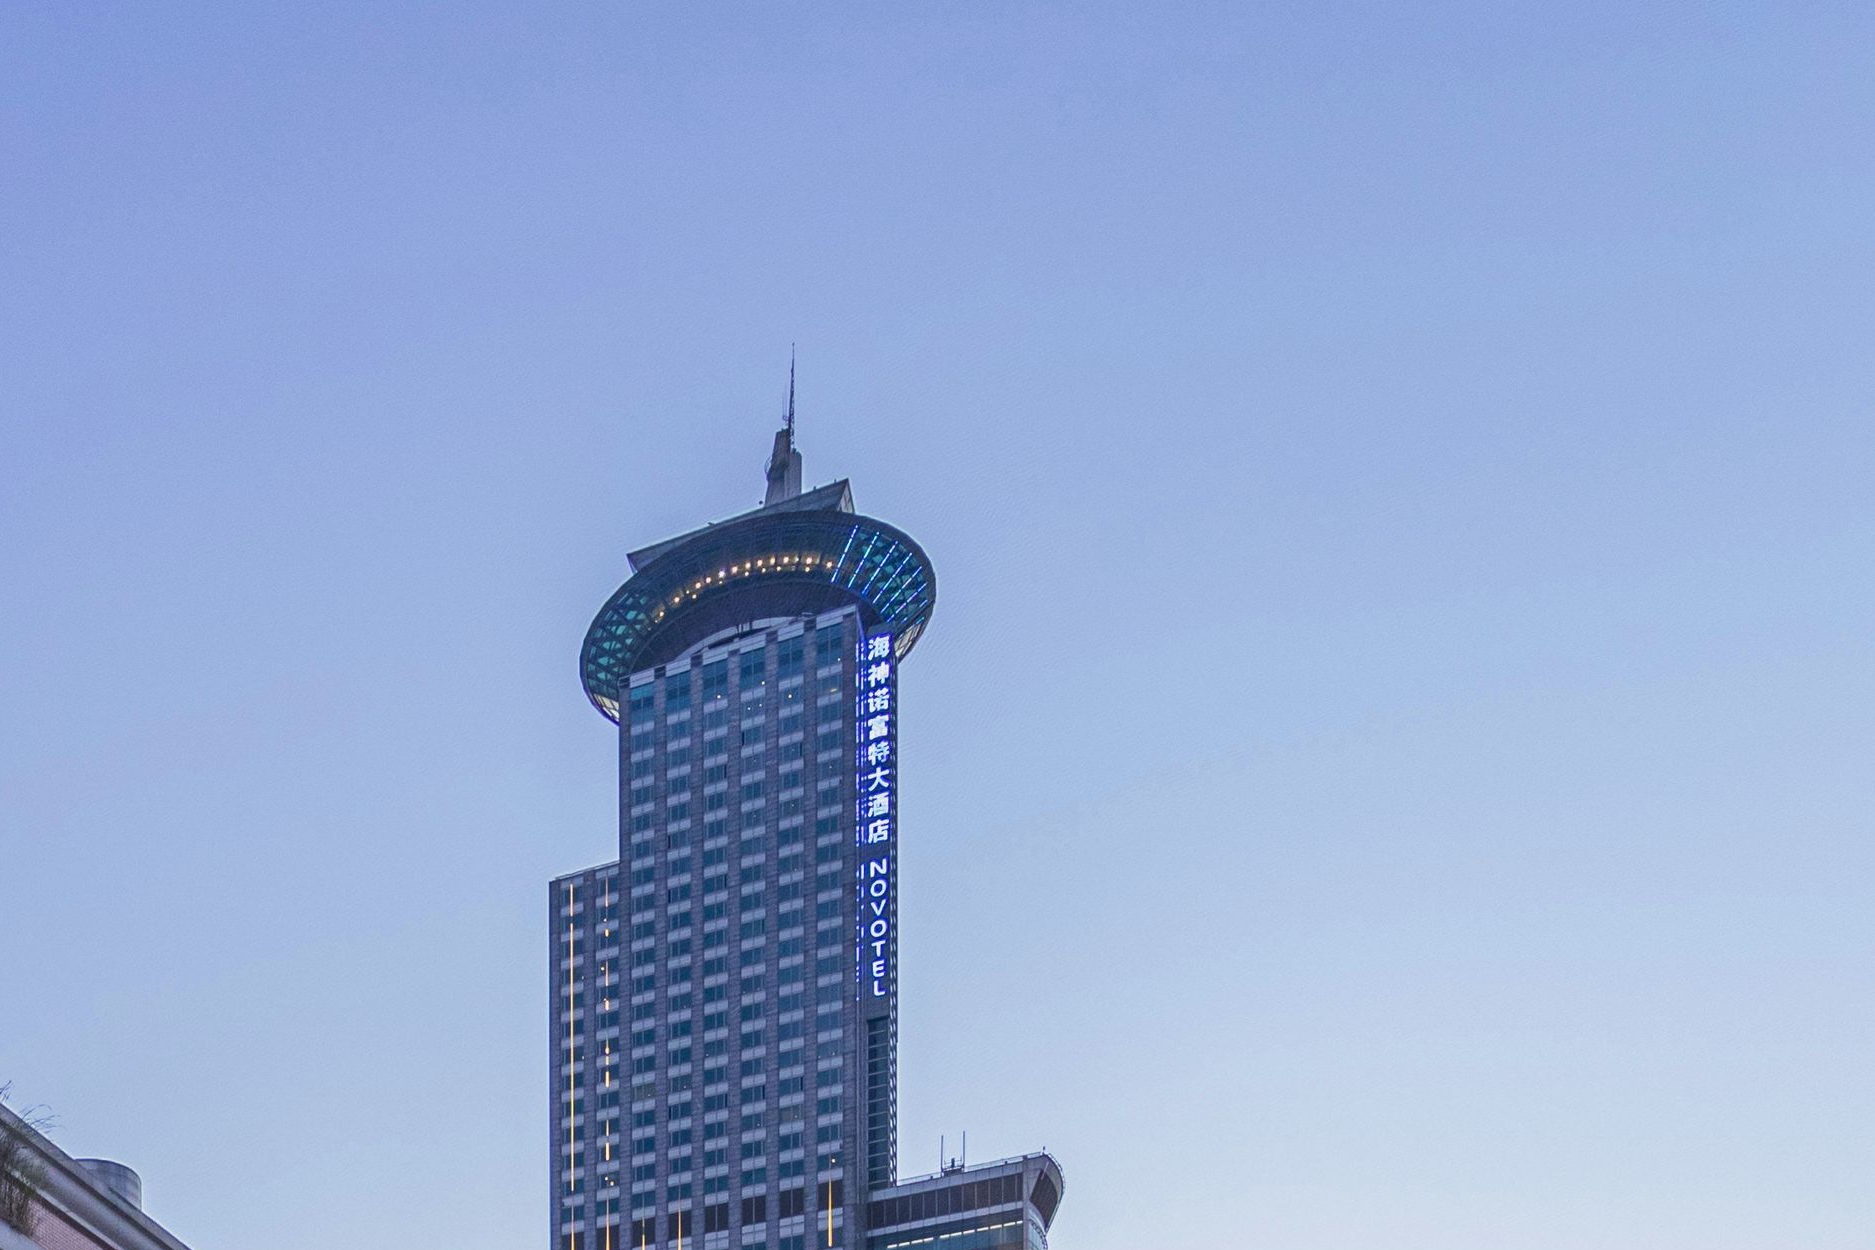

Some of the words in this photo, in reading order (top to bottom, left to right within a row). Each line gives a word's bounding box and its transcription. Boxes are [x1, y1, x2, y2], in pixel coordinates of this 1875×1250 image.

[867, 636, 891, 845] 海神诺富特大酒店
[869, 859, 888, 997] NOVOTEL
